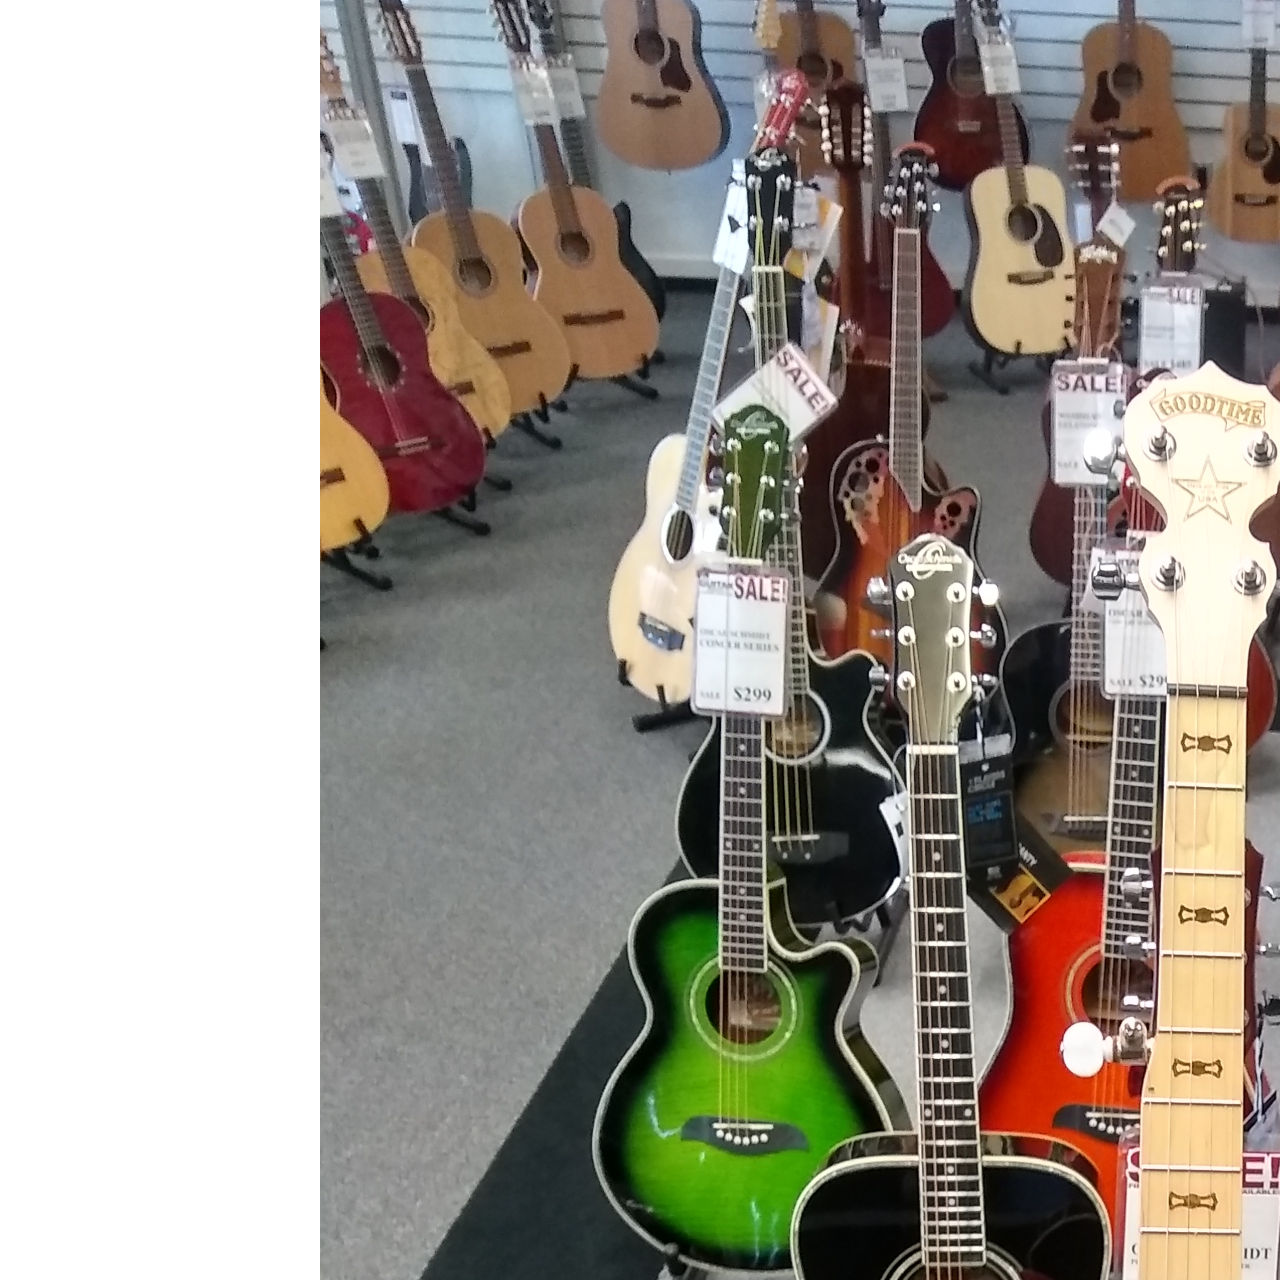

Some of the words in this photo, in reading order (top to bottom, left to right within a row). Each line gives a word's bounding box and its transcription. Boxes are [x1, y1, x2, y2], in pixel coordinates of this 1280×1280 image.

[1159, 393, 1264, 426] GOODTIME
[734, 575, 787, 603] SALE!
[1139, 675, 1167, 689] $29
[733, 687, 772, 701] $299
